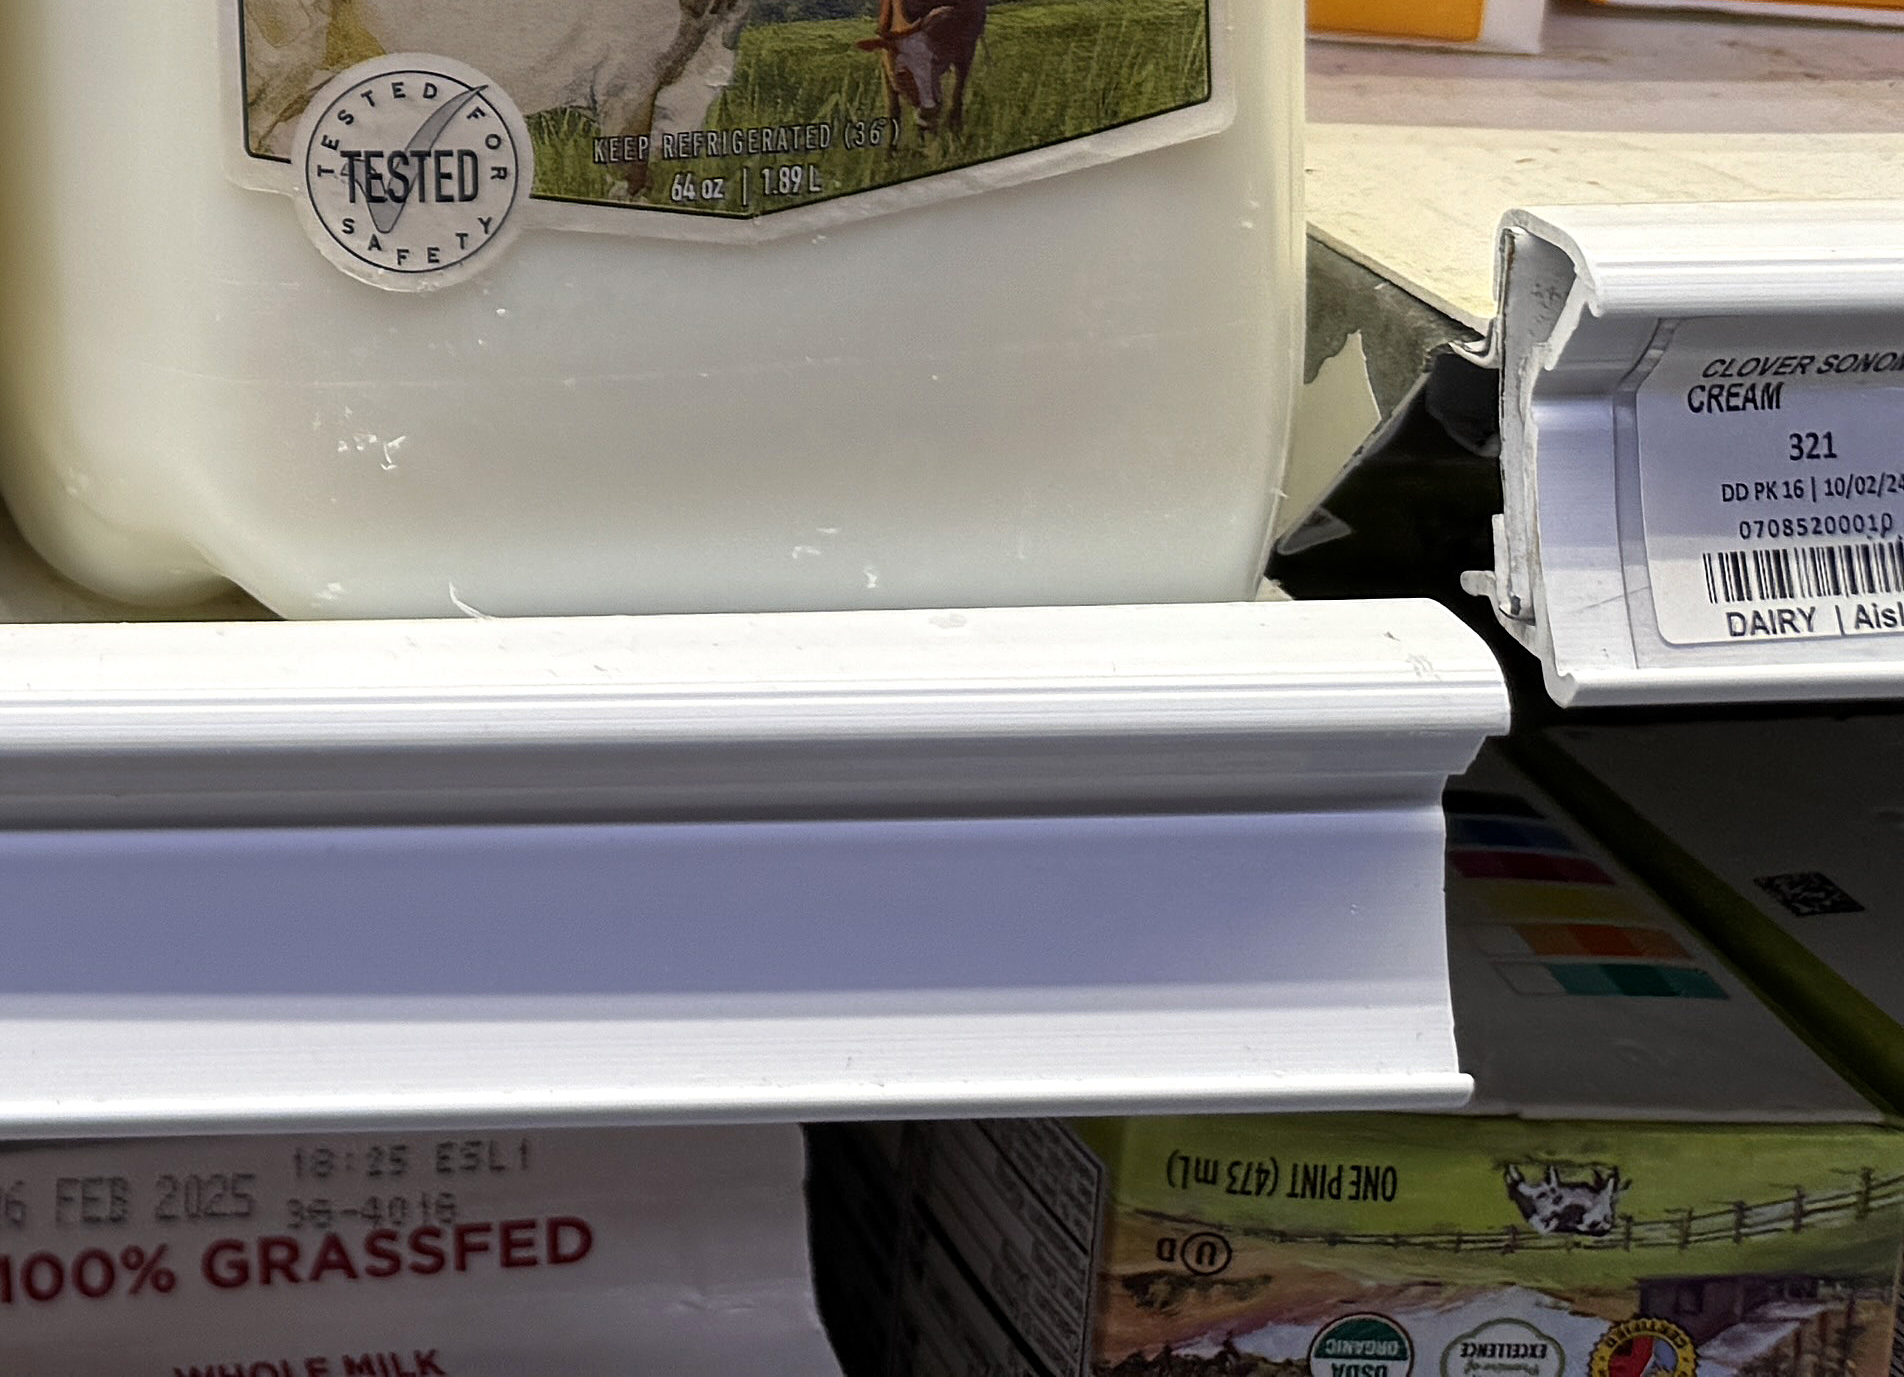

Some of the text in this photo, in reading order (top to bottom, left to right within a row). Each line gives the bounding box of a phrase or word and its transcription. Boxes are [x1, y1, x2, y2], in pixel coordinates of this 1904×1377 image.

[341, 150, 478, 204] TESTED
[1702, 355, 1815, 378] CLOVER
[1688, 382, 1784, 413] CREAM
[1789, 432, 1838, 461] 321
[1721, 479, 1804, 502] DD PK 16
[1726, 607, 1815, 637] DAIRY
[1167, 1149, 1397, 1201] ONE PINT (473 mL)
[56, 1177, 130, 1226] FEB
[155, 1173, 257, 1223] 2025
[202, 1215, 594, 1289] GRASSFED
